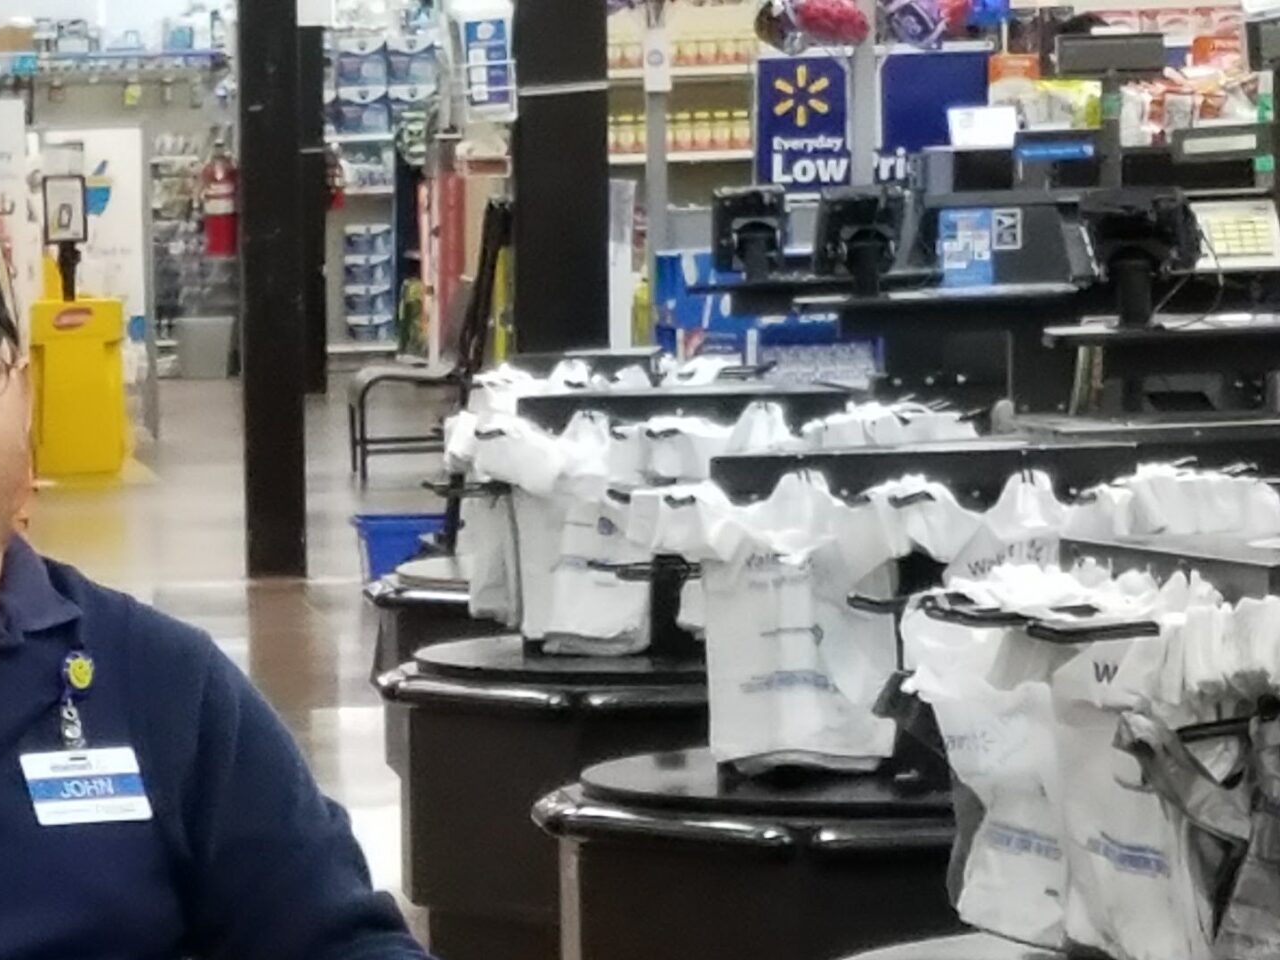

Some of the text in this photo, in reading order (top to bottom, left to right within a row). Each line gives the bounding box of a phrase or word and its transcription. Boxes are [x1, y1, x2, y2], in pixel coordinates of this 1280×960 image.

[772, 136, 844, 152] Everyday
[772, 153, 849, 183] Low
[60, 776, 115, 799] JOHN
